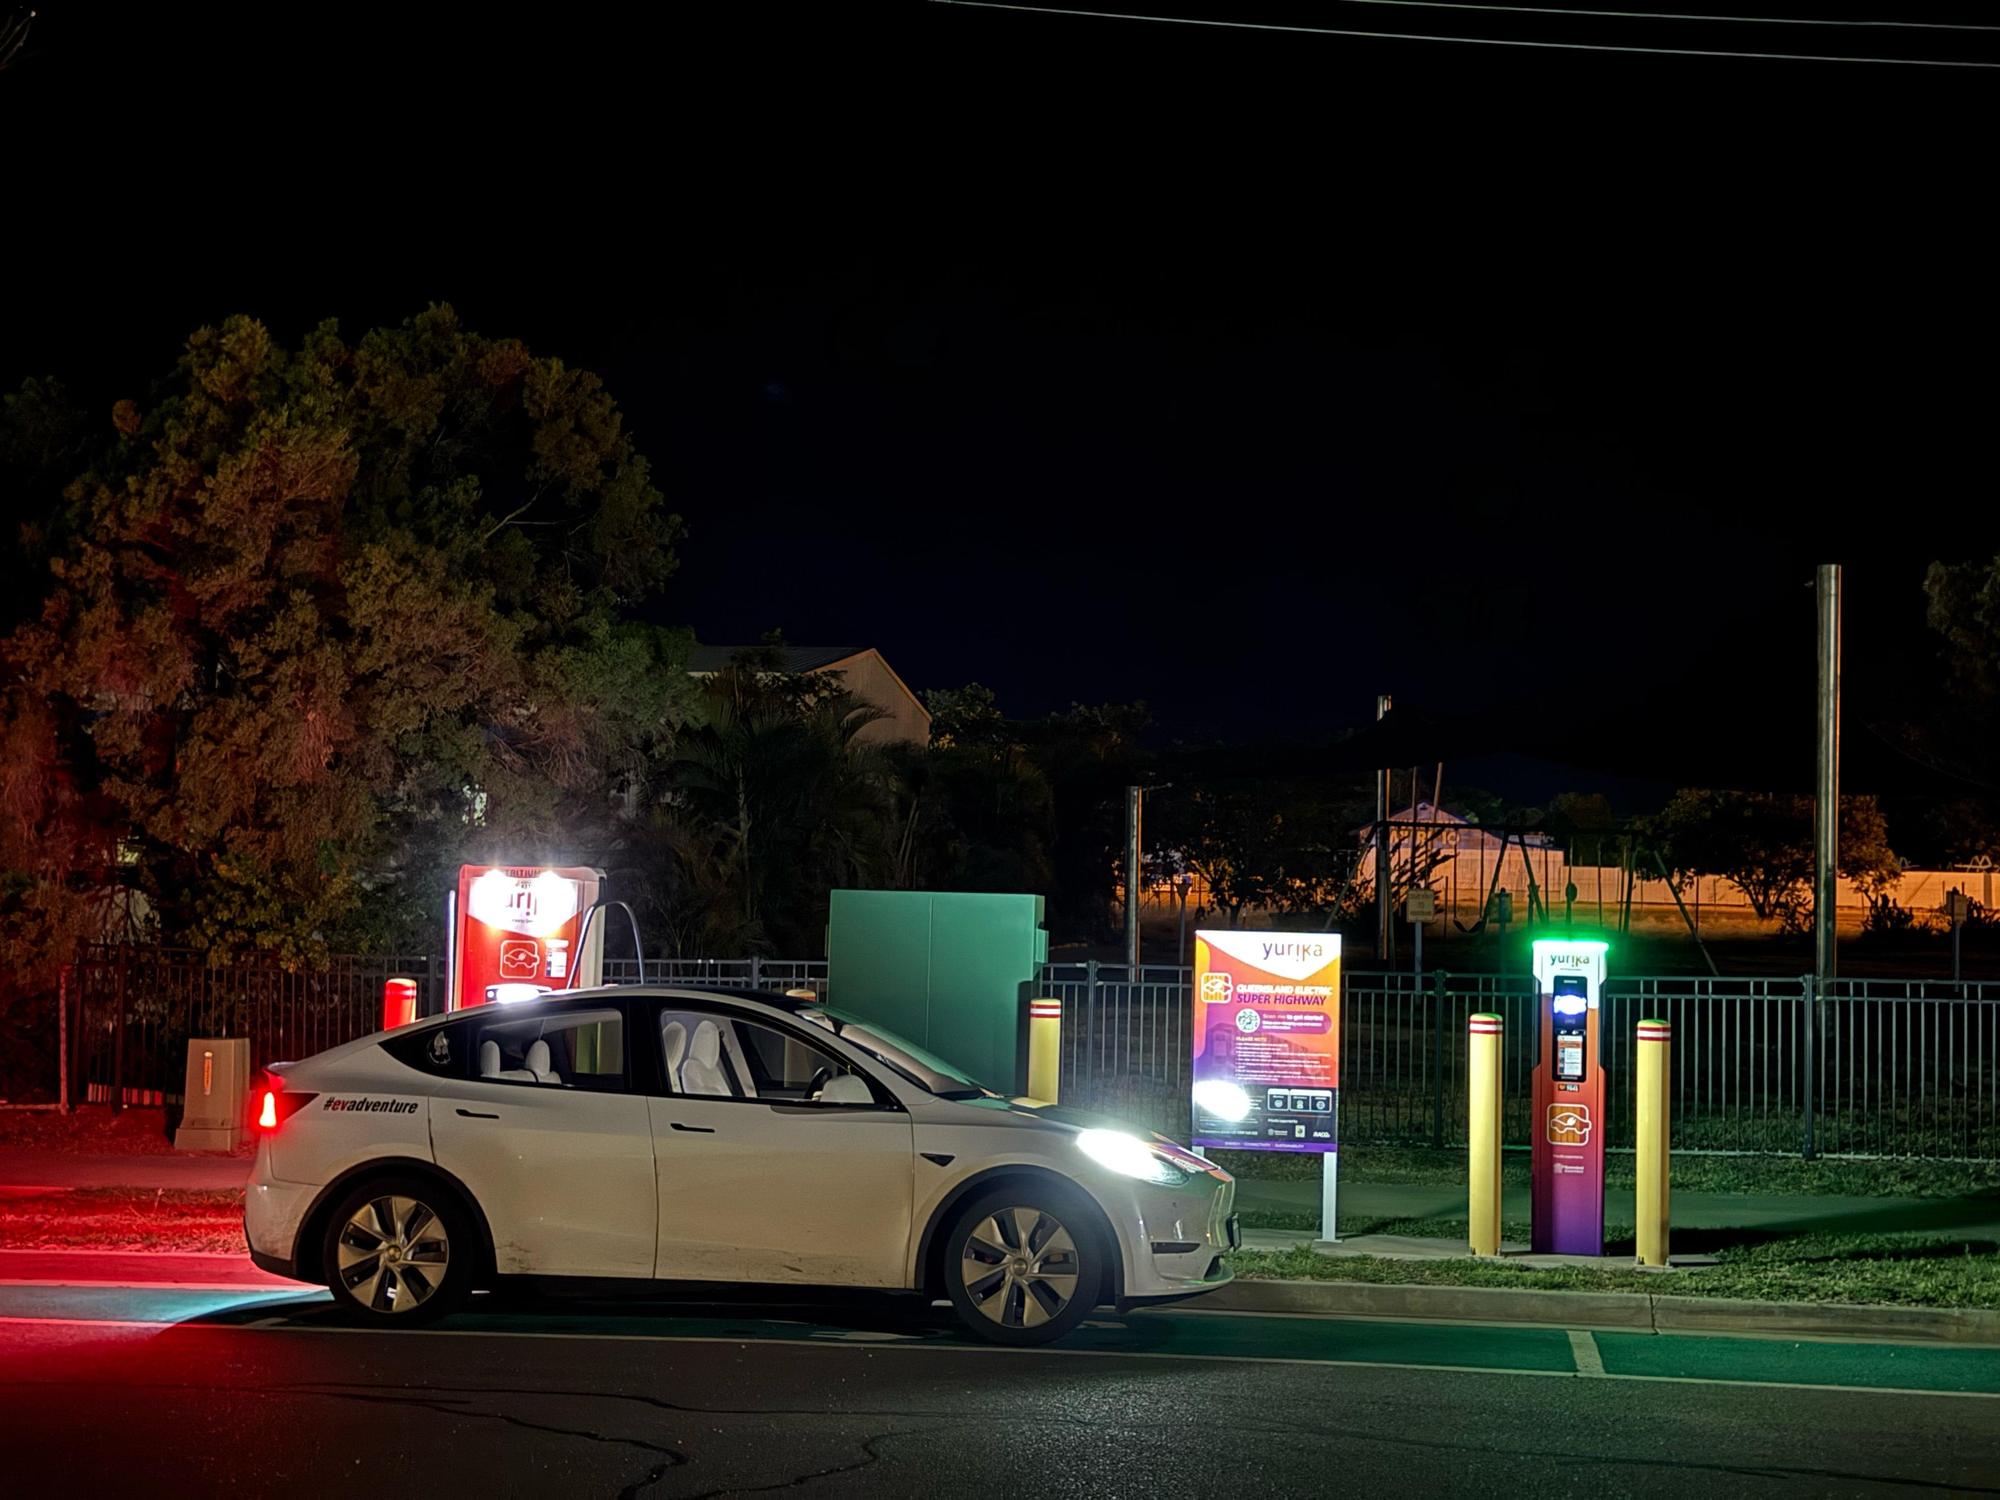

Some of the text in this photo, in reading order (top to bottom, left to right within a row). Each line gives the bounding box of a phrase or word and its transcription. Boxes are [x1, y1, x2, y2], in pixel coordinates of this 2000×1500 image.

[1263, 941, 1323, 962] yurika
[1550, 954, 1590, 967] yurika
[1236, 993, 1327, 1006] SUPER HIGHWAY
[323, 1096, 419, 1114] #evadventure
